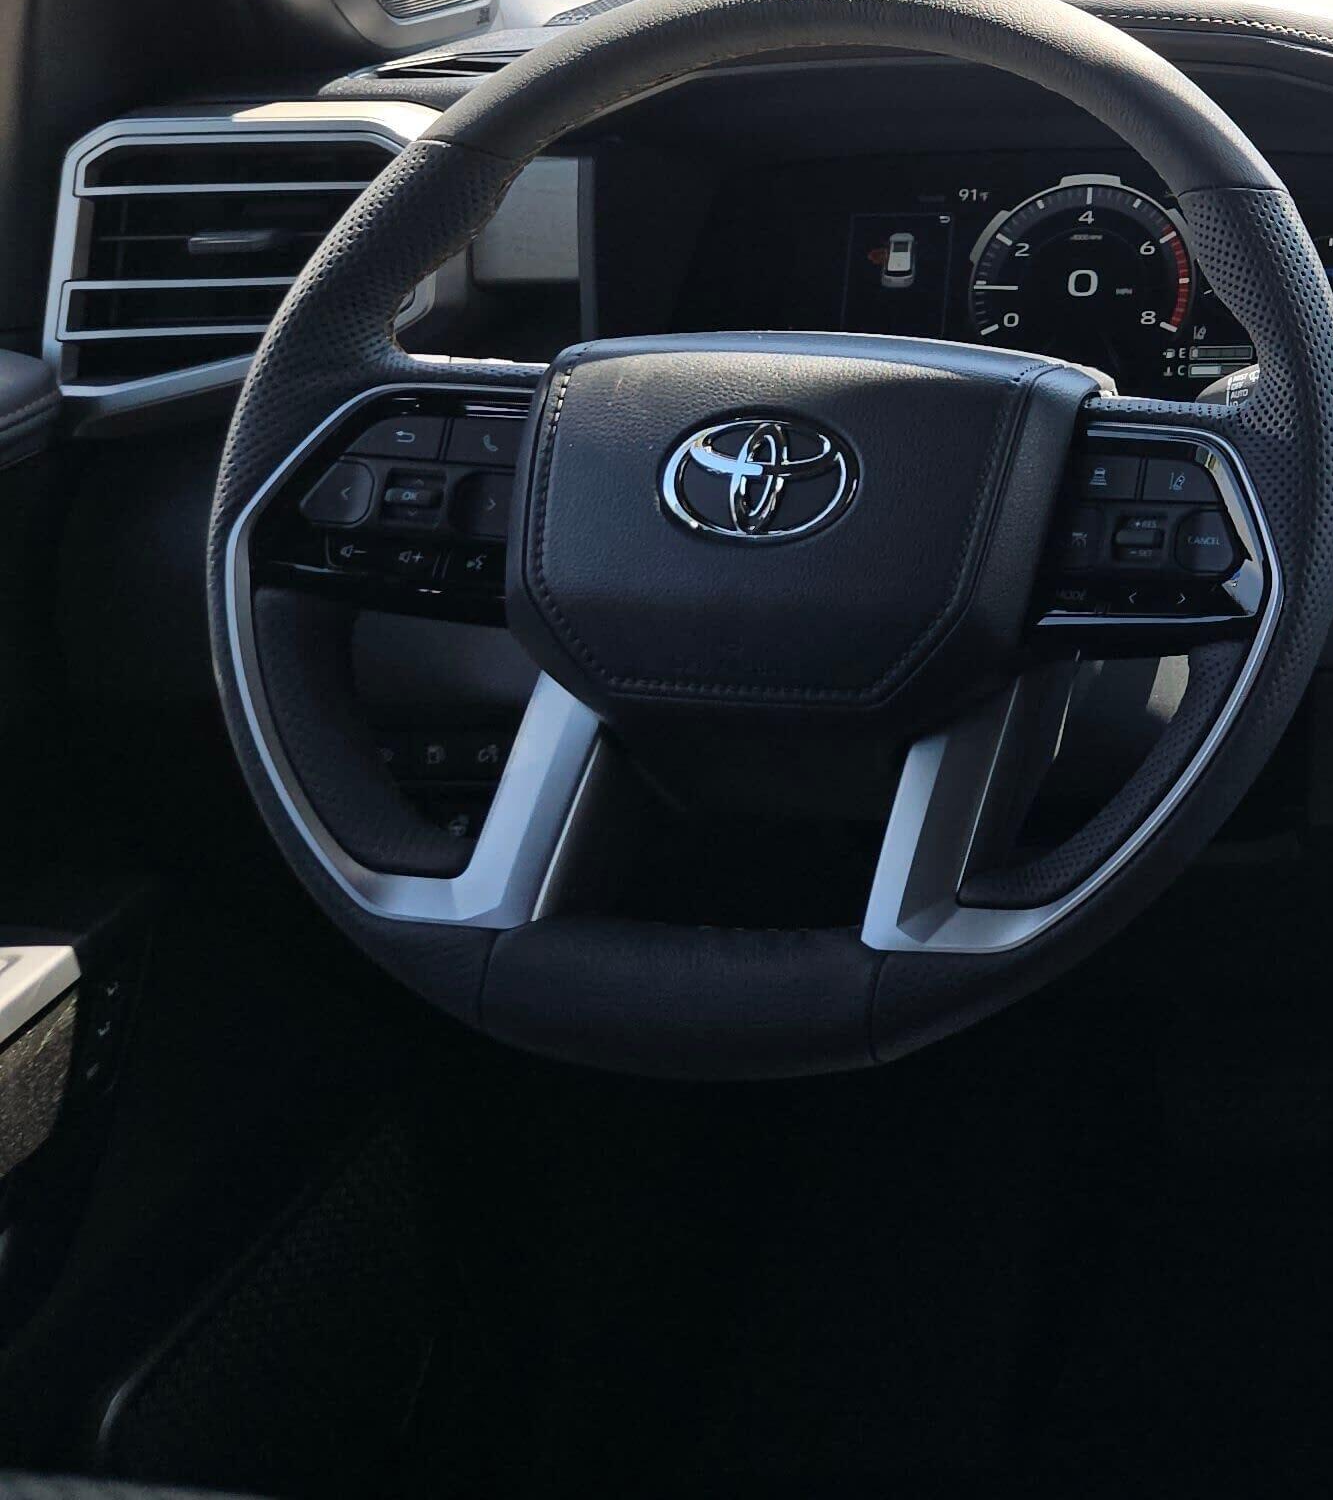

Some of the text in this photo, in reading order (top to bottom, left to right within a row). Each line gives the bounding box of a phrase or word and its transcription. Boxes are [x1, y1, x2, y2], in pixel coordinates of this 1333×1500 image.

[1078, 210, 1094, 224] 4
[1015, 243, 1030, 257] 2
[1140, 242, 1156, 255] 6
[1067, 269, 1099, 296] 0
[1003, 312, 1019, 327] 0
[1141, 311, 1156, 325] 8
[1179, 348, 1186, 359] E
[1177, 365, 1186, 377] C
[1231, 389, 1249, 399] AUTO
[1187, 536, 1220, 546] CANCEL
